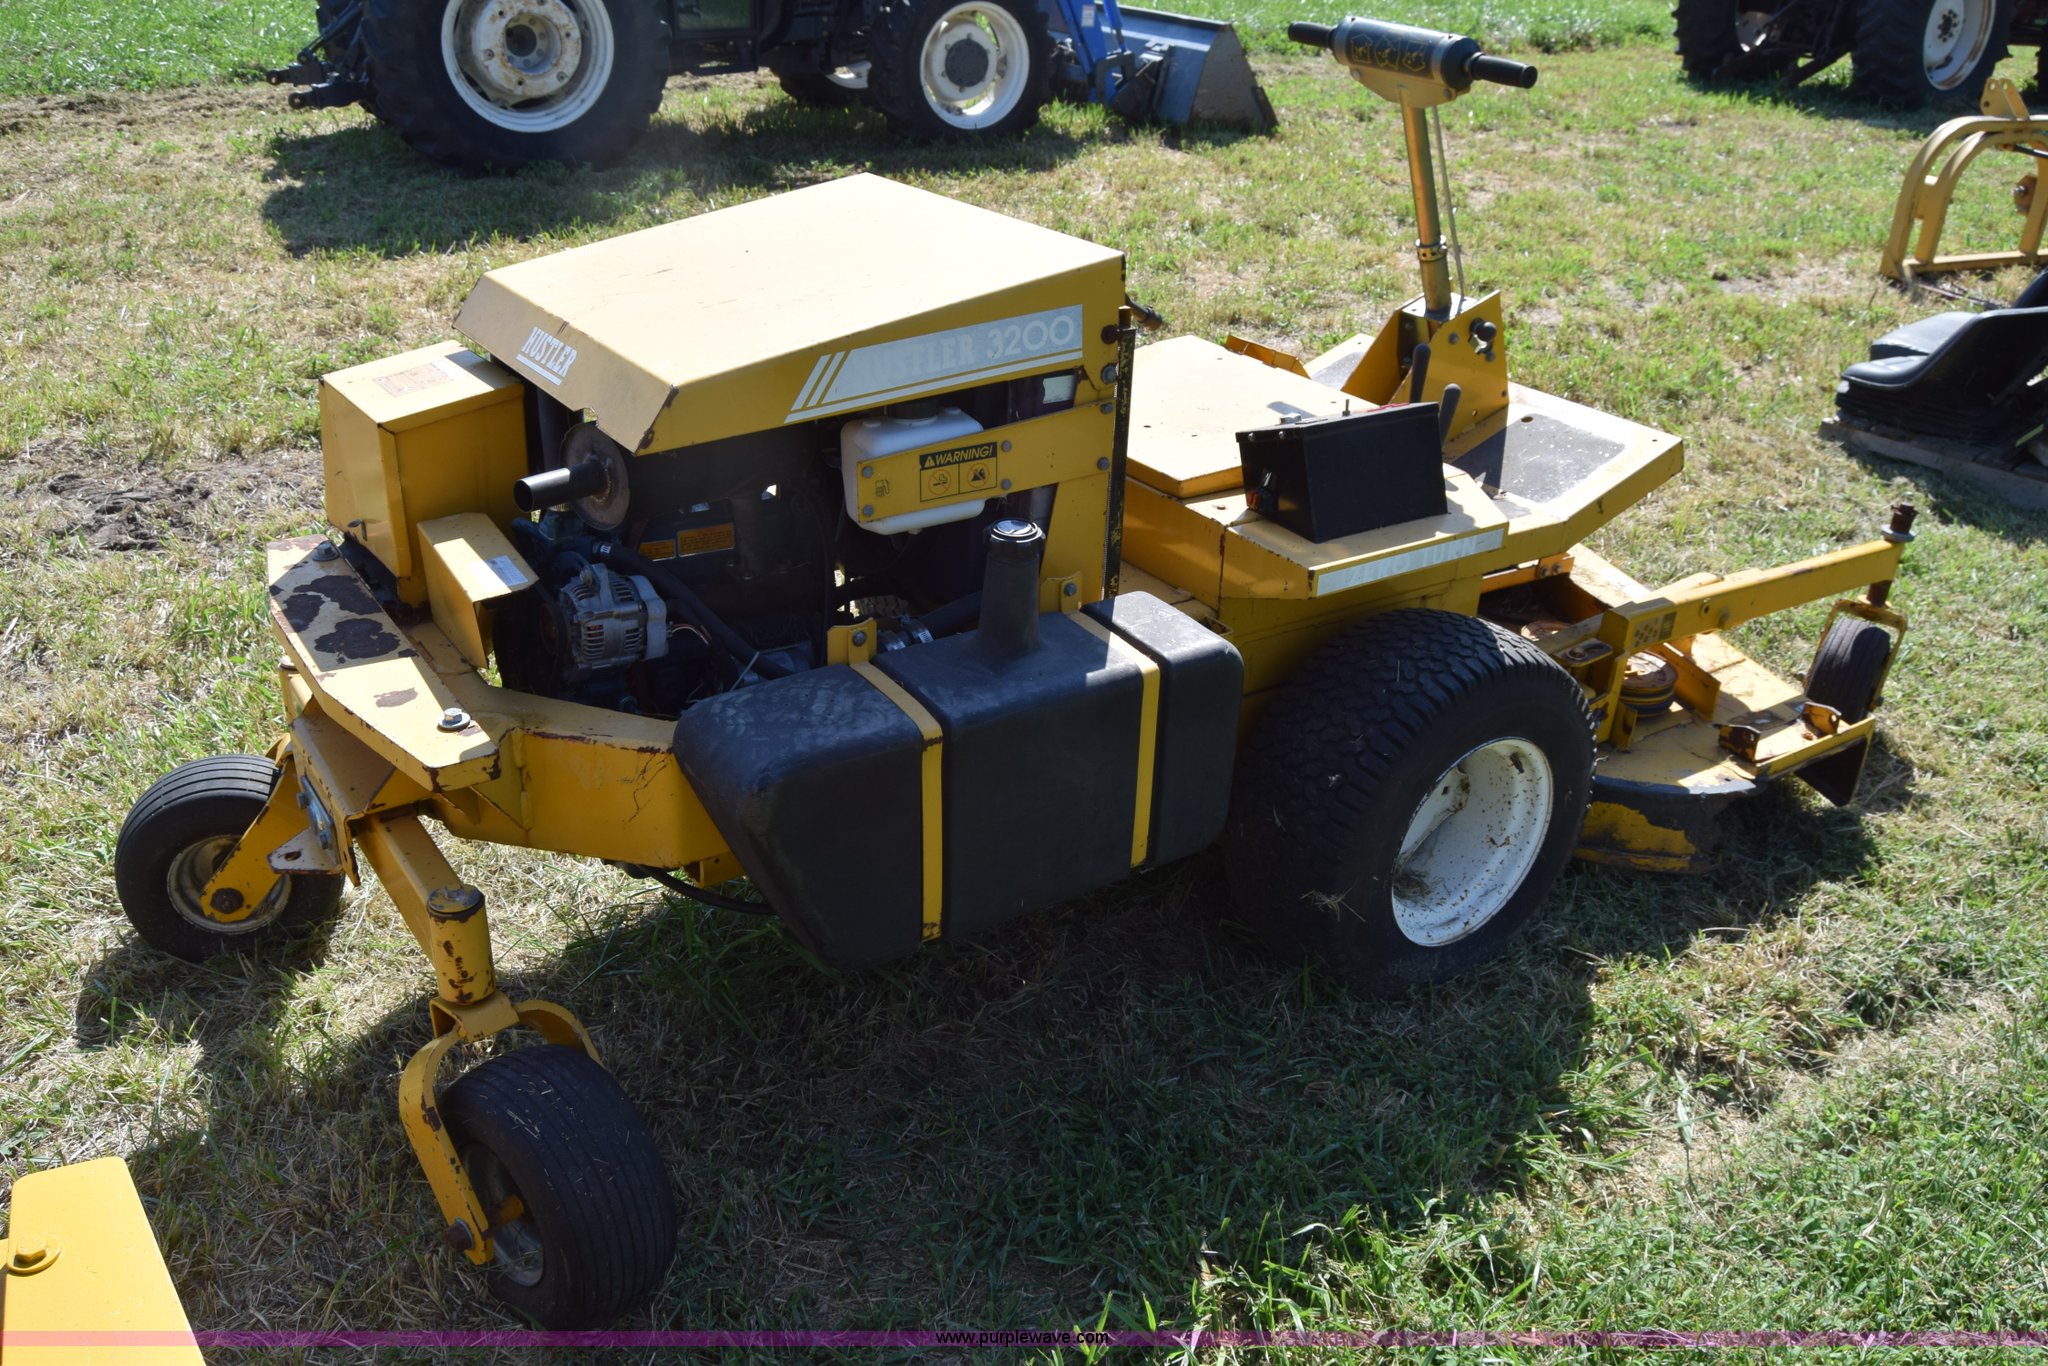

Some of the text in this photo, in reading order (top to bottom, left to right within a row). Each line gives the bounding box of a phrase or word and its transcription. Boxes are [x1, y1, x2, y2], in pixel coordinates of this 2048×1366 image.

[521, 326, 577, 378] HUSTLER
[988, 315, 1075, 360] 3200
[936, 445, 993, 466] WARNING!
